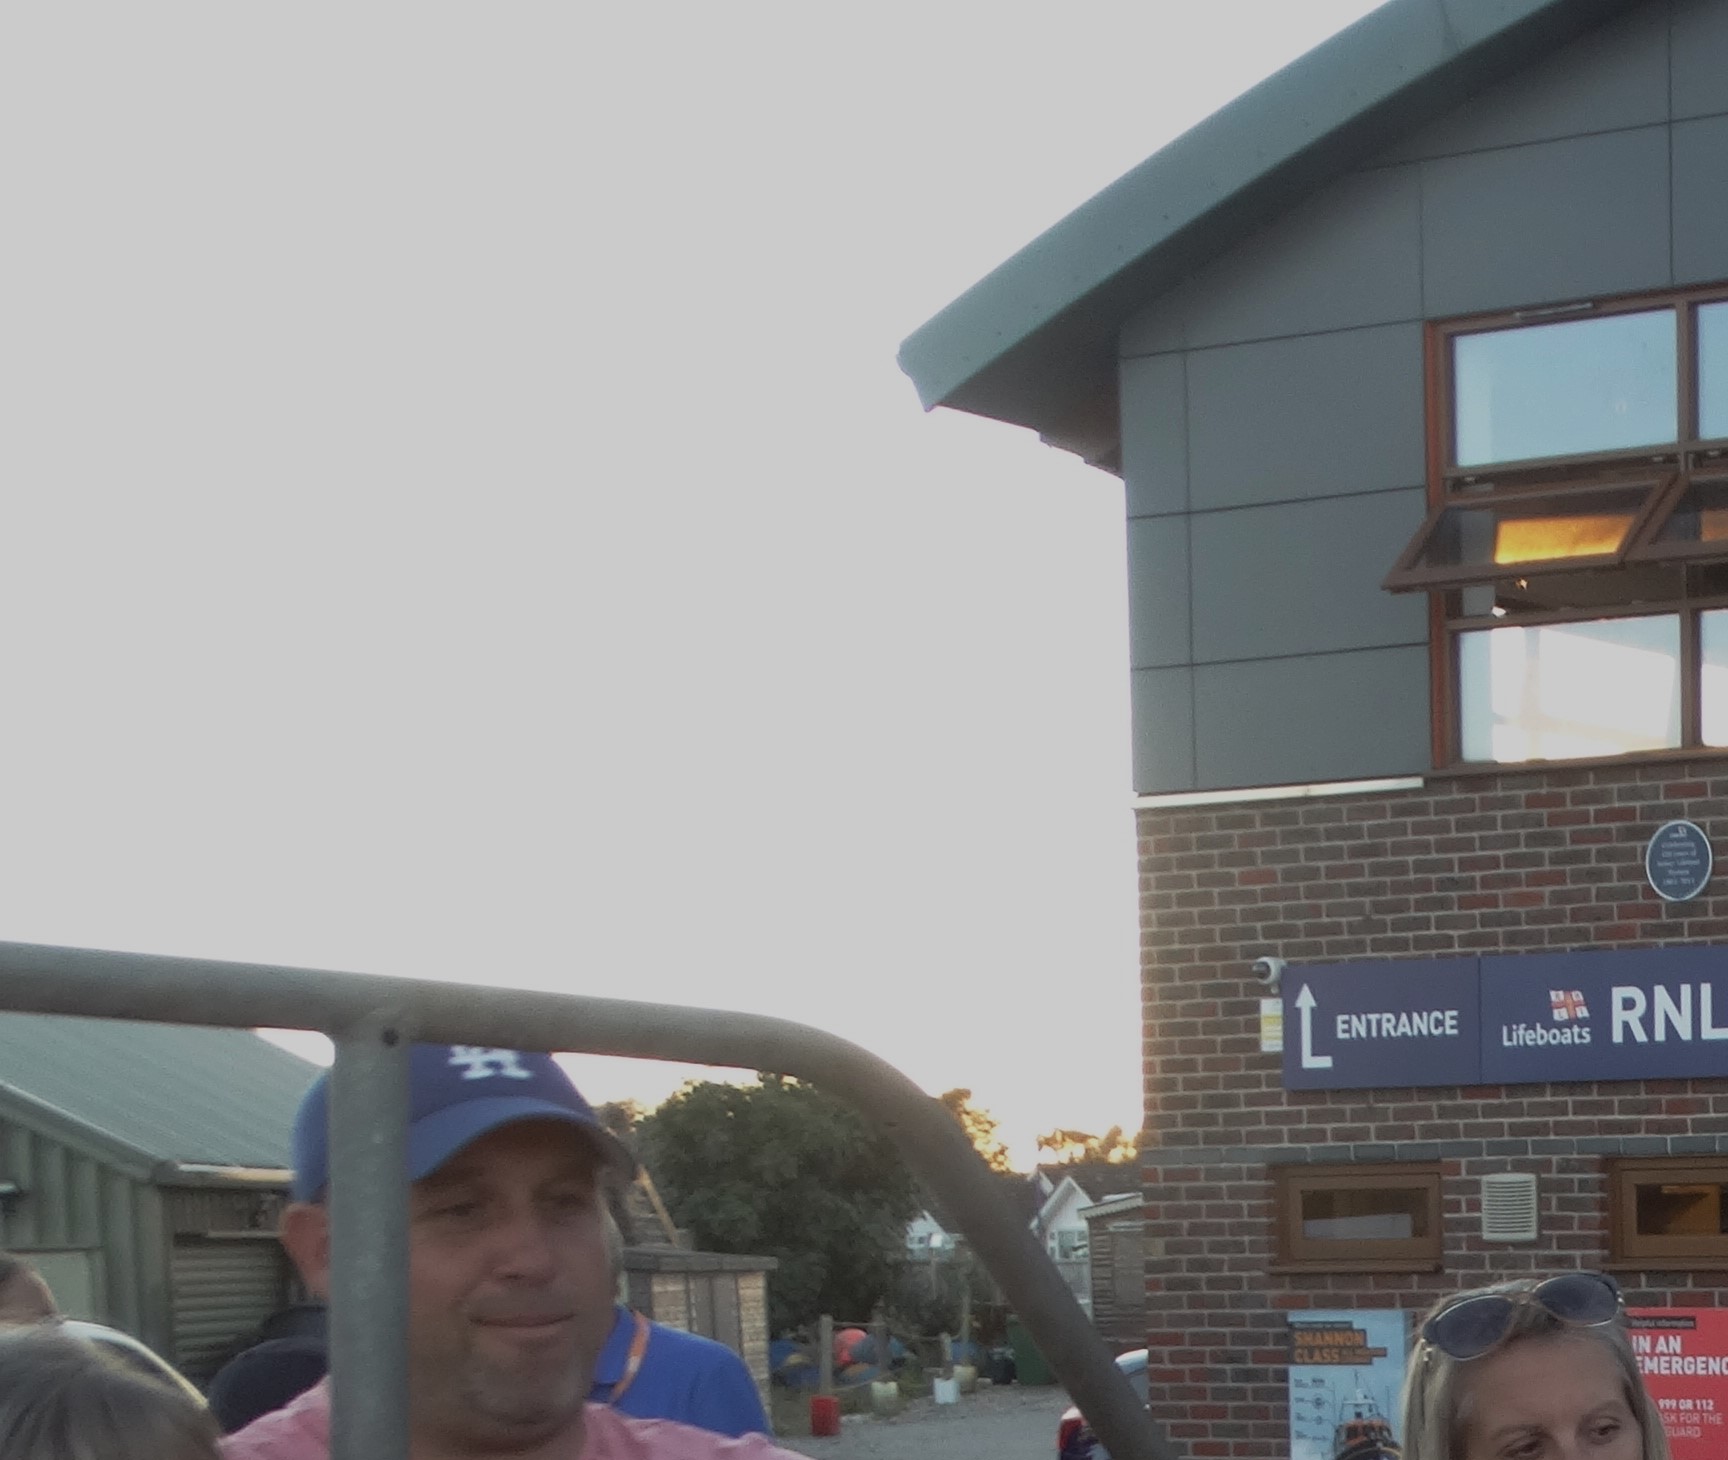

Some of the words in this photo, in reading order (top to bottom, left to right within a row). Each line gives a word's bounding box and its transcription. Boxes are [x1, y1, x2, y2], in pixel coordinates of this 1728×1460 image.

[1336, 1010, 1459, 1040] ENTRANCE
[1502, 1022, 1592, 1047] Lifeboats
[1294, 1331, 1364, 1347] SHANNON
[1631, 1335, 1650, 1354] IN
[1656, 1335, 1681, 1354] AN
[1294, 1348, 1340, 1363] CLASS
[1659, 1398, 1677, 1410] 999
[1679, 1399, 1693, 1410] OR
[1695, 1399, 1714, 1411] 112
[1680, 1413, 1700, 1425] FOR
[1703, 1413, 1723, 1425] THE
